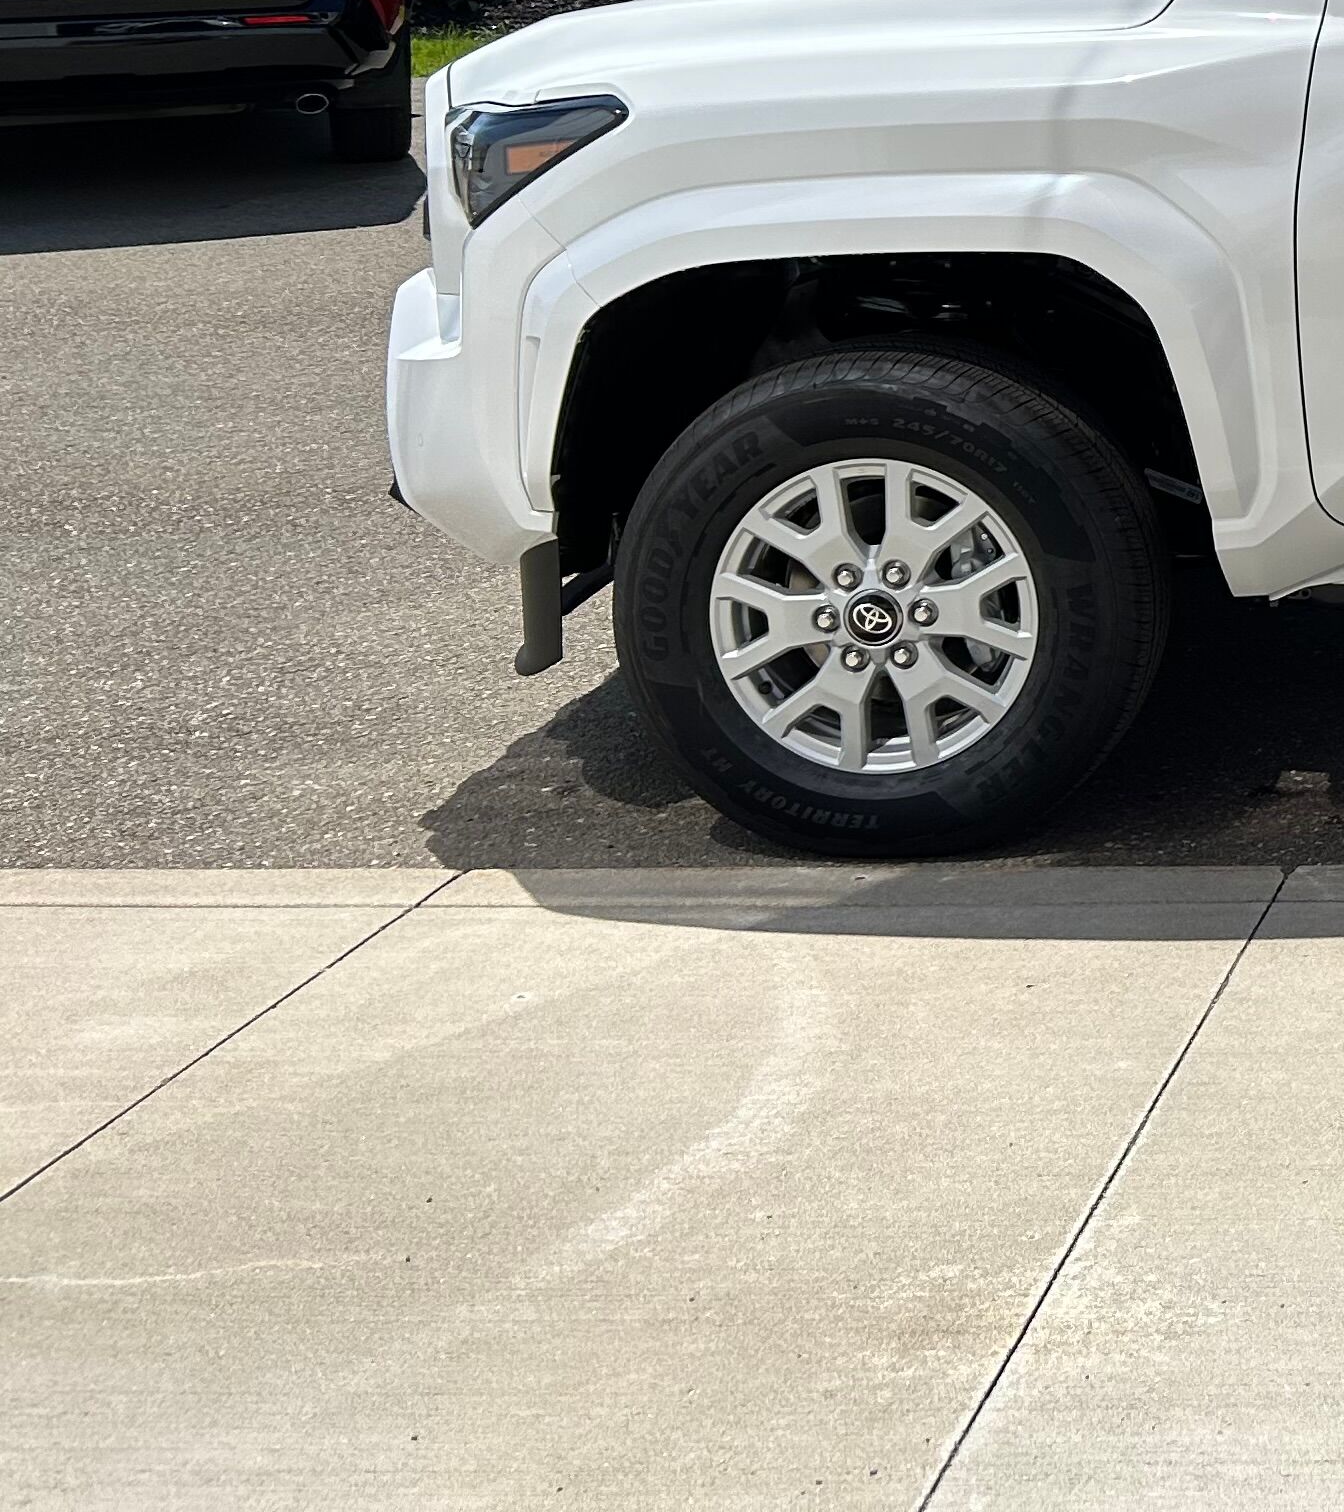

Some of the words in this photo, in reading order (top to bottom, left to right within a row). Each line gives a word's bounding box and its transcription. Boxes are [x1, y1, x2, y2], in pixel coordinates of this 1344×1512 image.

[892, 417, 1008, 473] 245/70R17
[640, 430, 764, 662] GOODYEAR
[737, 779, 882, 830] TERRITORY
